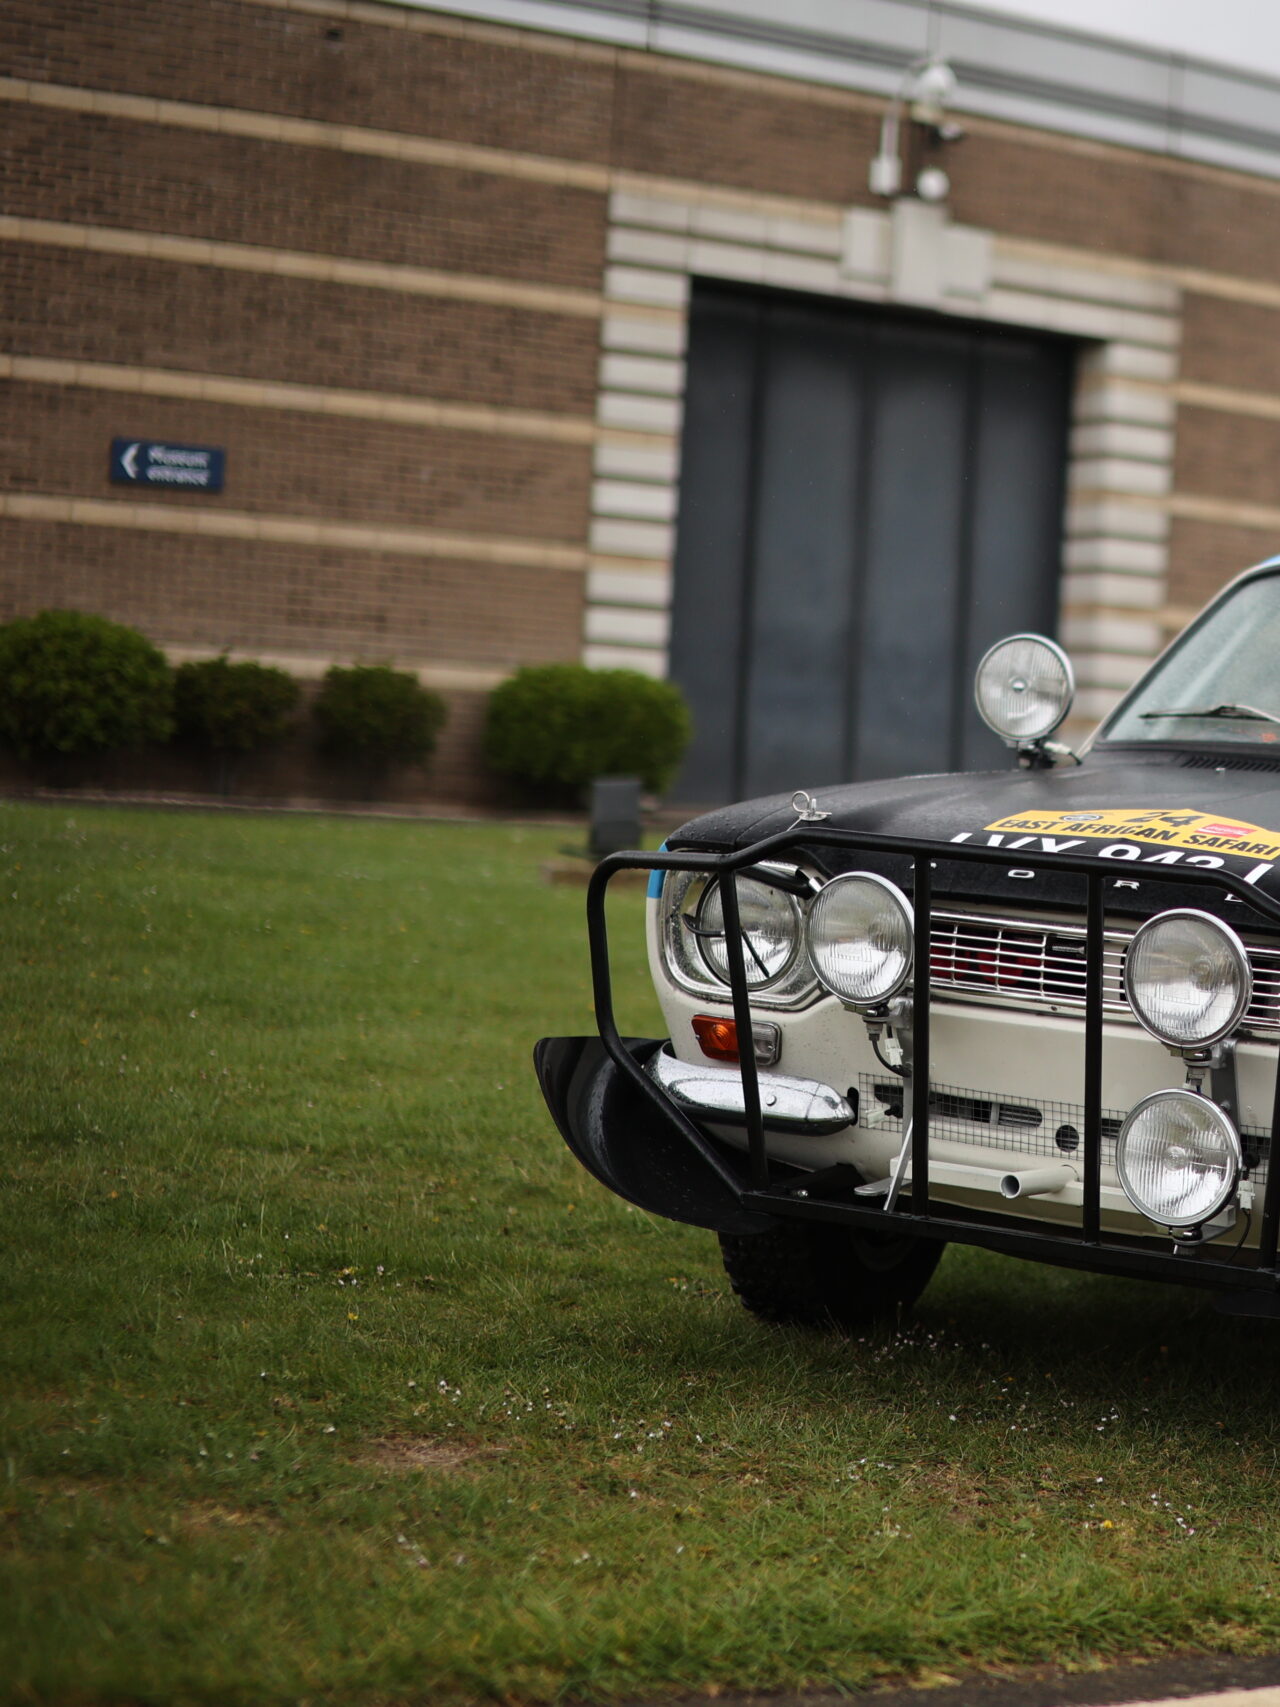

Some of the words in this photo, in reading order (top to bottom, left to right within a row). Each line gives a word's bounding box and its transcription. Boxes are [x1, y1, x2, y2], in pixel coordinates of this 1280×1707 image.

[1123, 811, 1205, 828] 24
[997, 819, 1065, 831] EAST
[1061, 822, 1179, 842] AFRICAN
